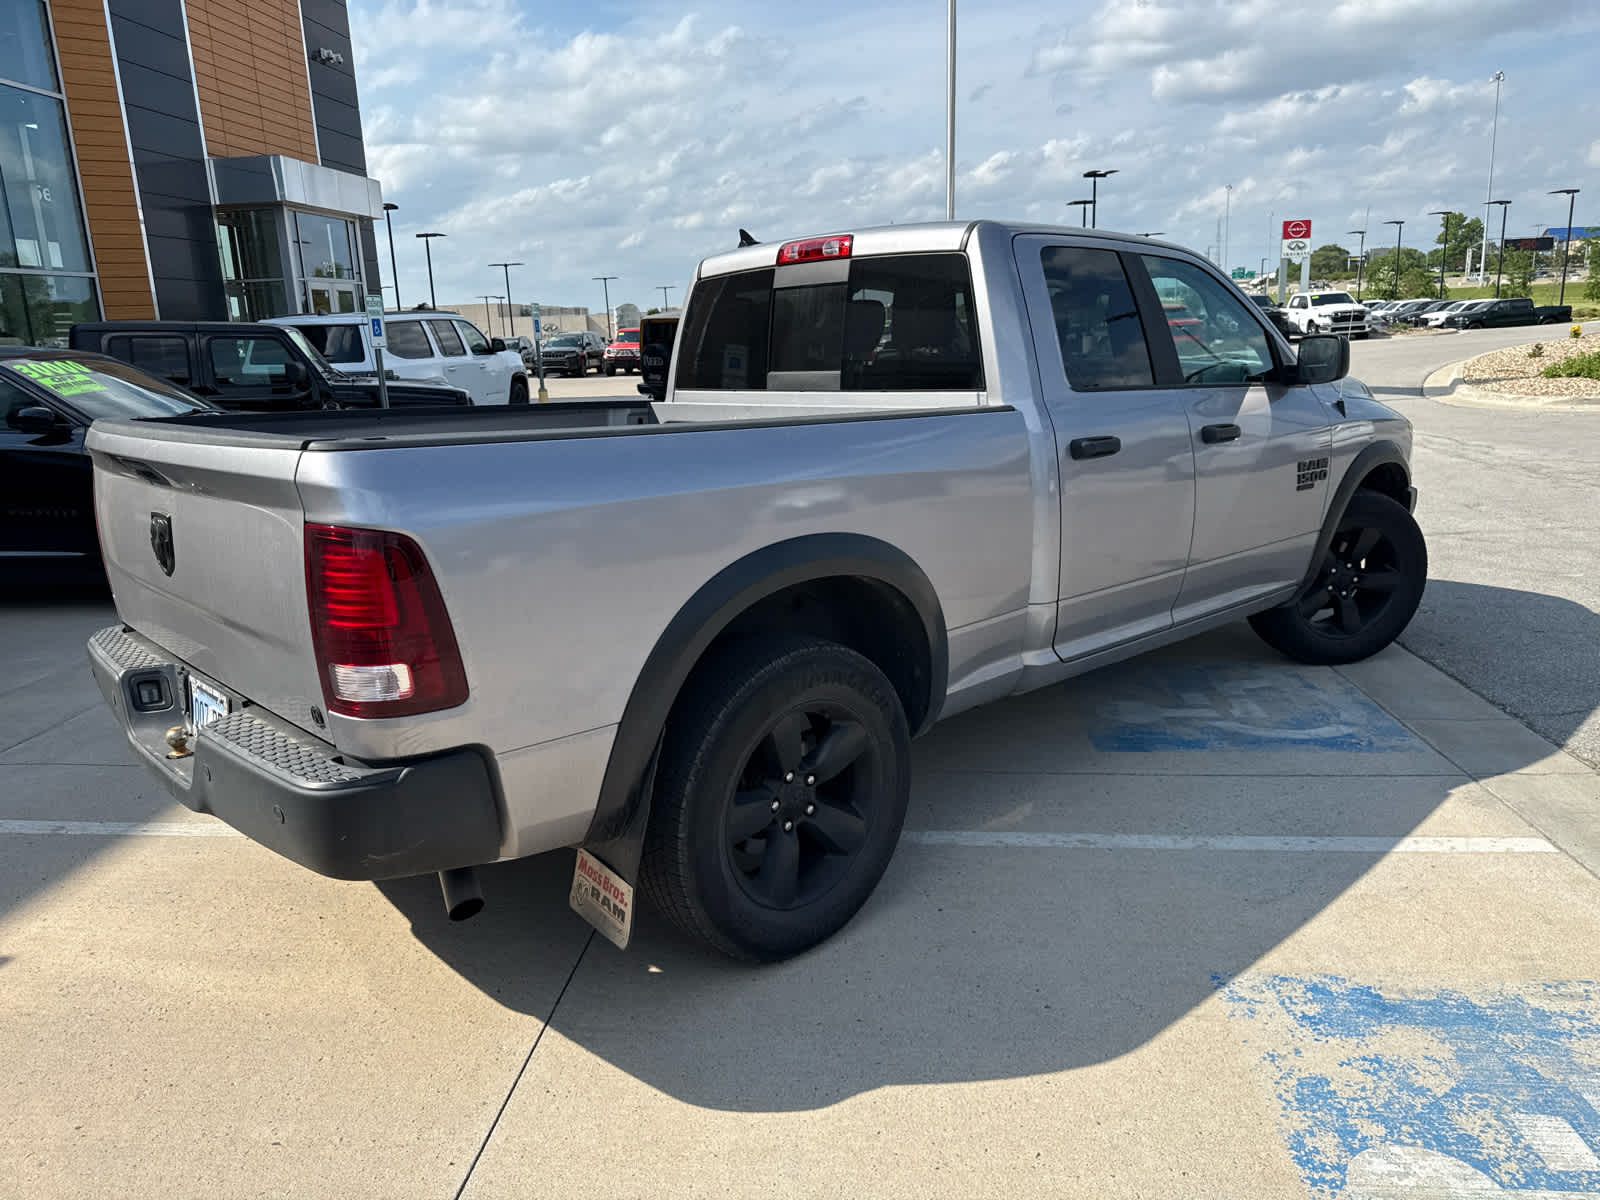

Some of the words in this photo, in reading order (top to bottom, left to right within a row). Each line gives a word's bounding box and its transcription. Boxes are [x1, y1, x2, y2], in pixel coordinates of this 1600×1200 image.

[1297, 470, 1327, 484] 1500
[578, 856, 602, 885] Moss
[603, 876, 628, 908] Bros.
[591, 886, 625, 923] RAM
